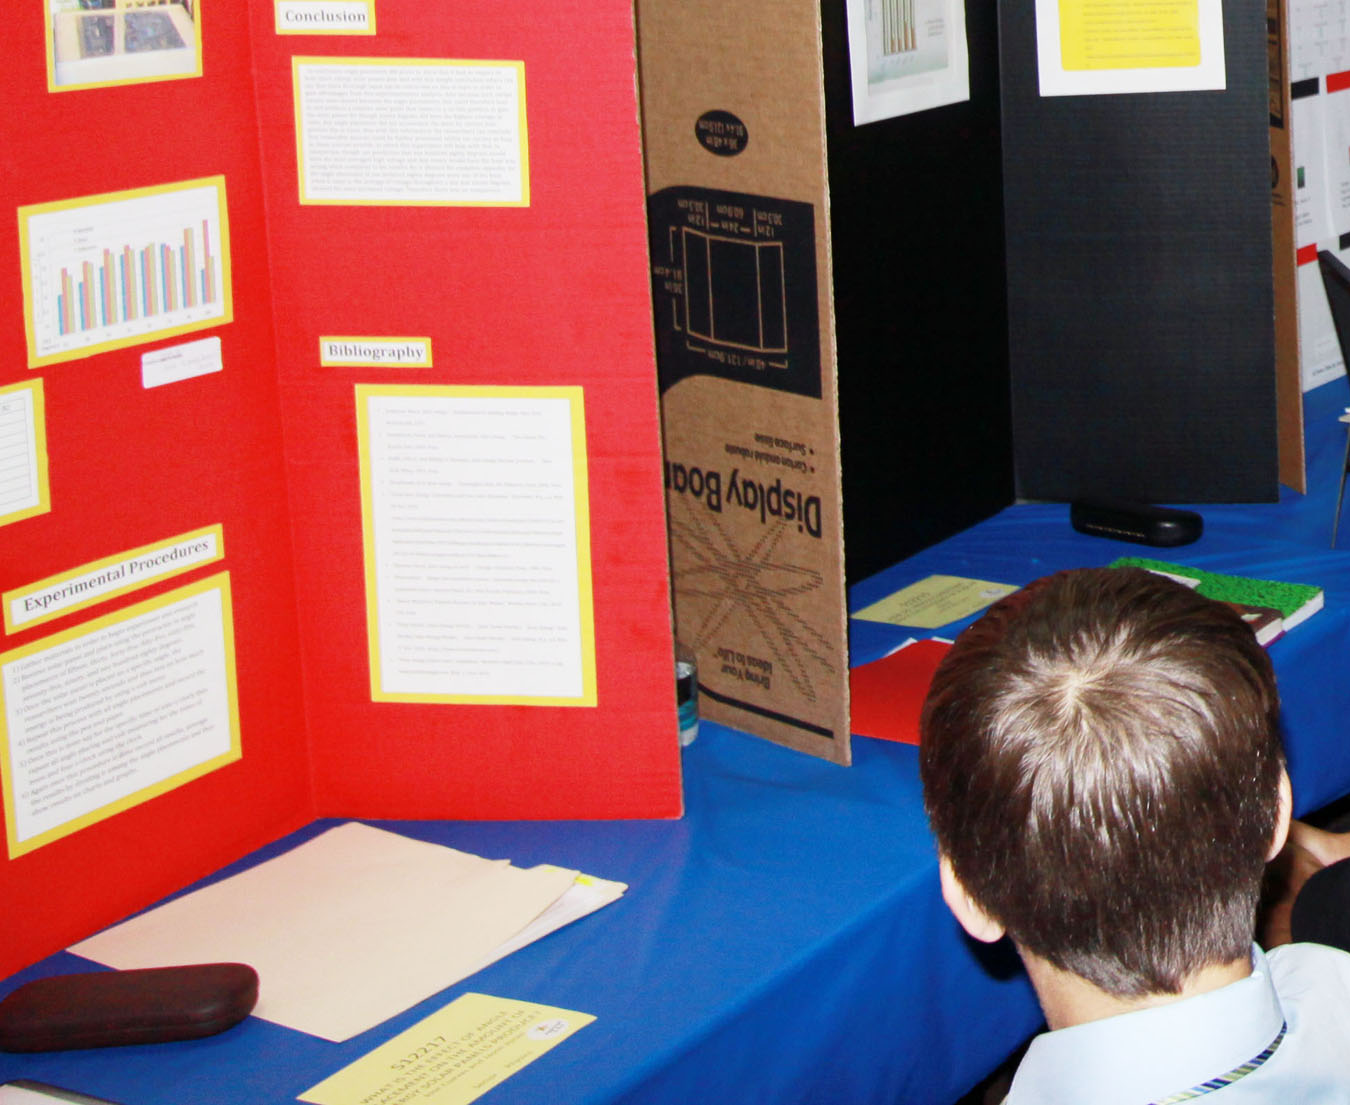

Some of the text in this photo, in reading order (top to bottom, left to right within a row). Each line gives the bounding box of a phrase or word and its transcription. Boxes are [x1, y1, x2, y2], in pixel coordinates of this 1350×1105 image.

[285, 8, 367, 24] Conclusion
[328, 342, 424, 362] Bibliography
[726, 468, 822, 539] Display
[24, 540, 209, 613] Experimental Procedures
